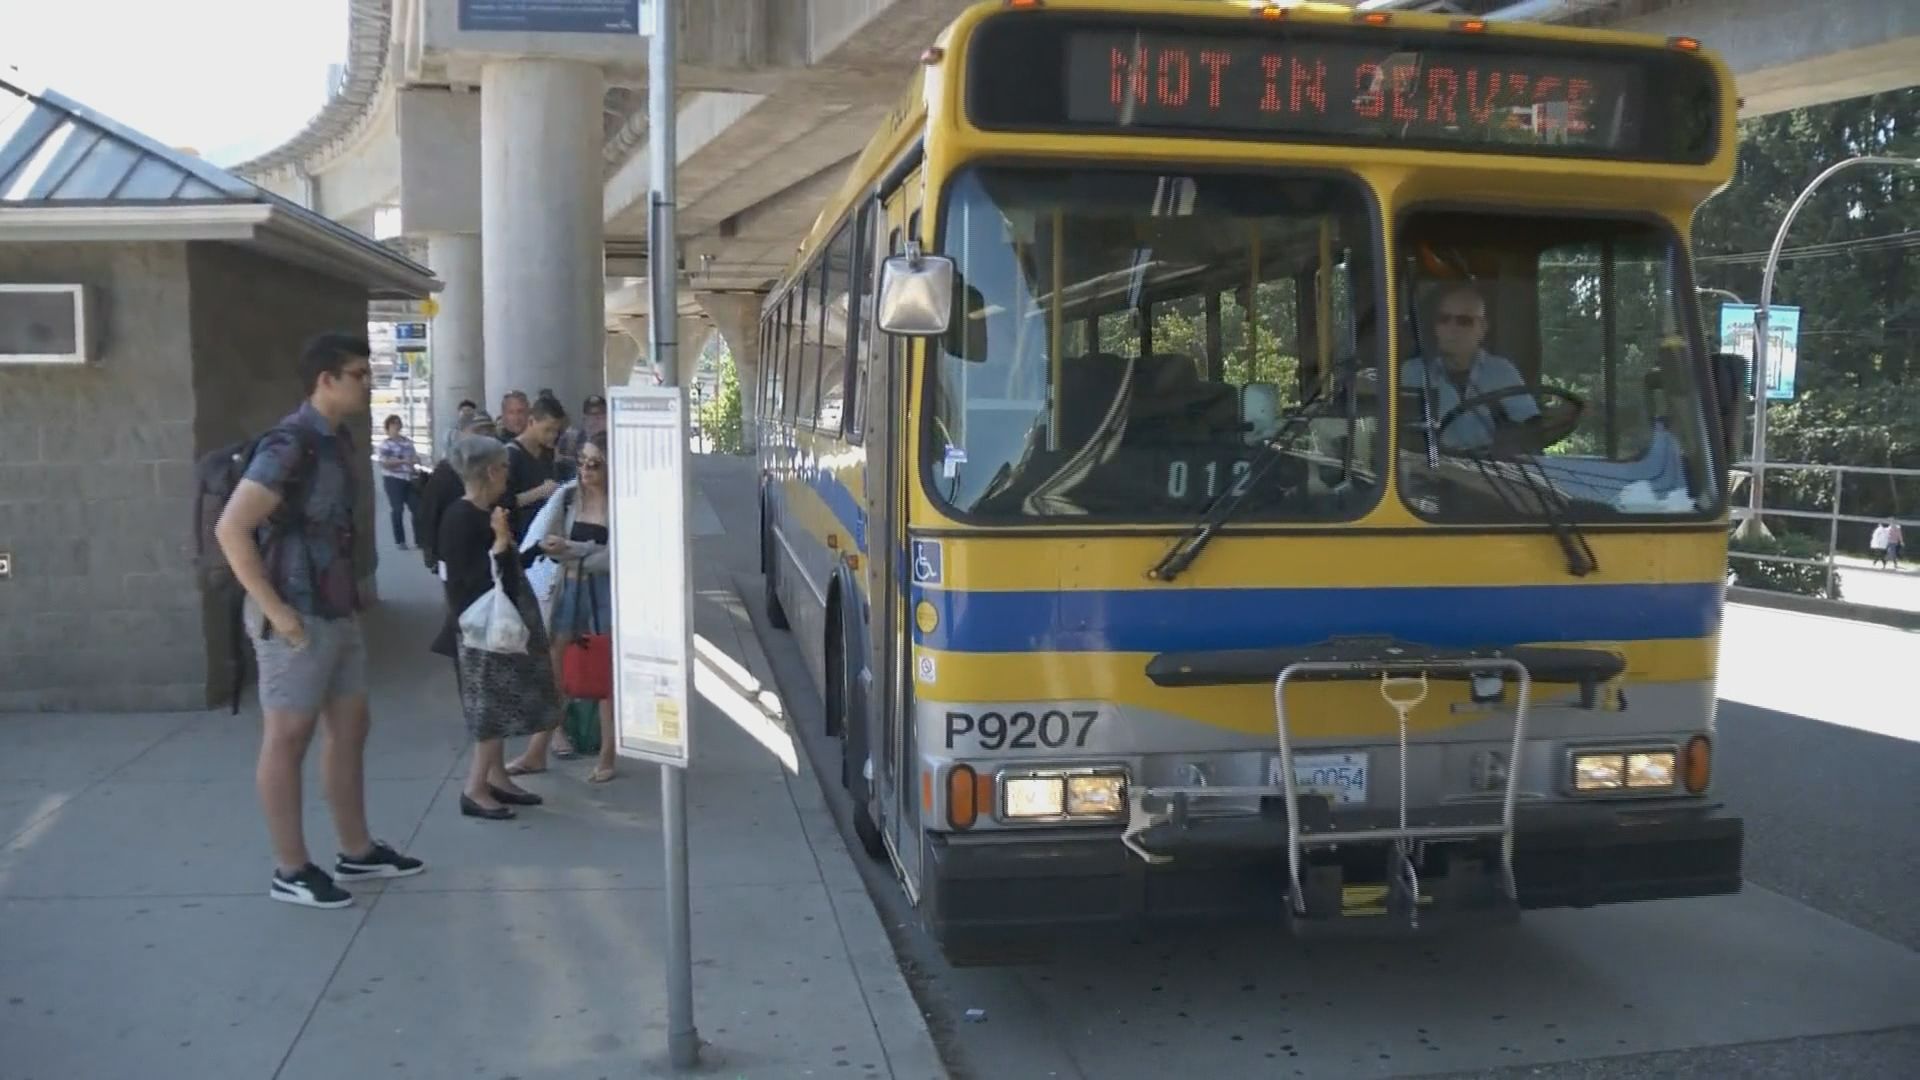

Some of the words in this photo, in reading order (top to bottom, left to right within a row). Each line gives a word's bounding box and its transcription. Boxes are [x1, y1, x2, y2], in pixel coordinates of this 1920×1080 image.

[1110, 46, 1231, 110] NOT
[1260, 54, 1326, 114] IN
[1352, 62, 1593, 132] SERVICE
[945, 710, 1099, 751] P9207
